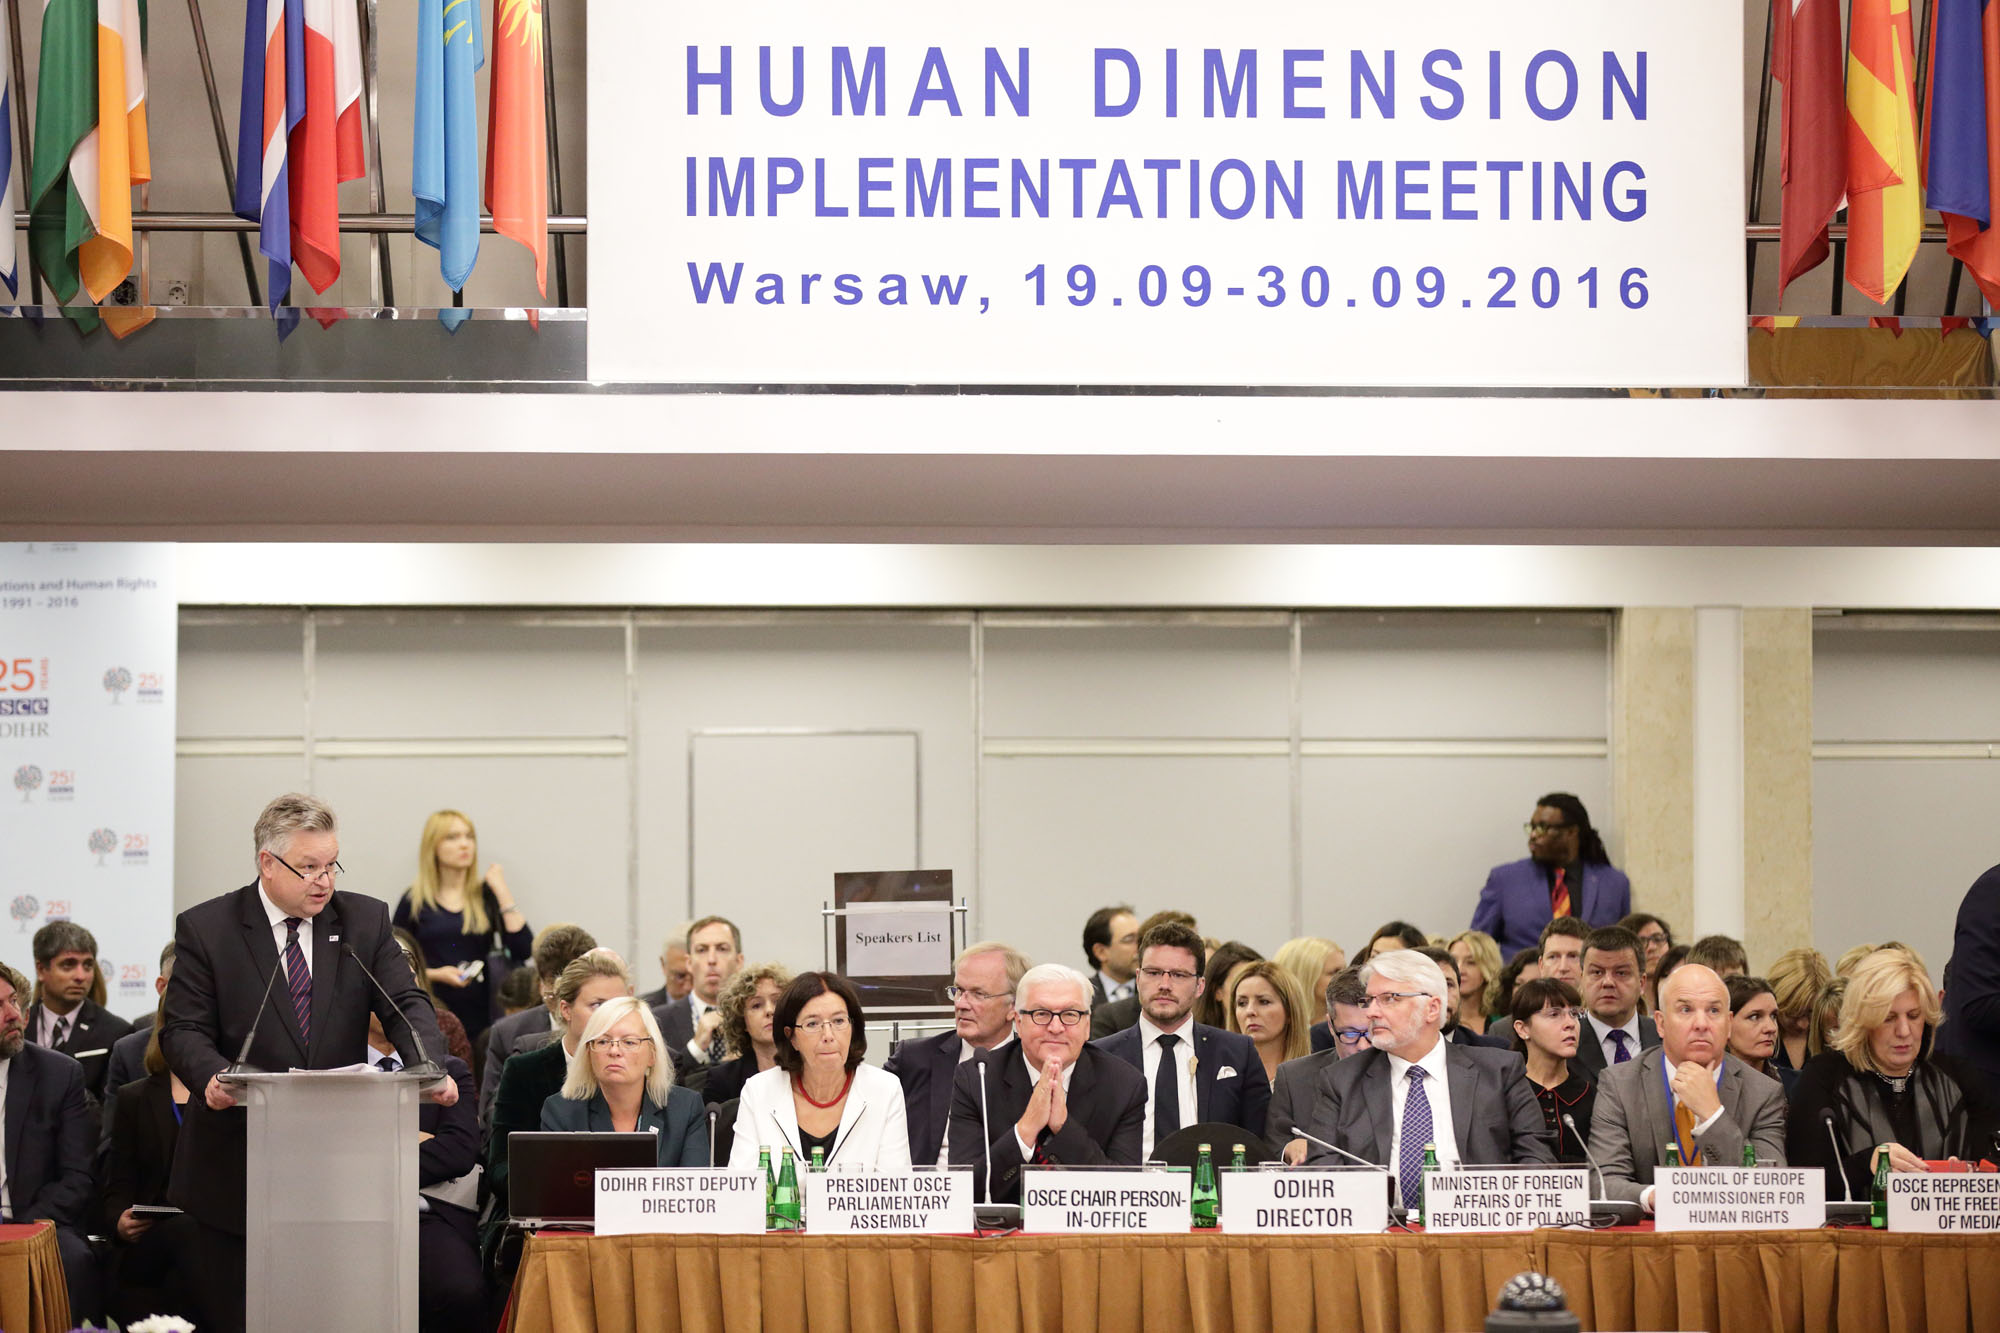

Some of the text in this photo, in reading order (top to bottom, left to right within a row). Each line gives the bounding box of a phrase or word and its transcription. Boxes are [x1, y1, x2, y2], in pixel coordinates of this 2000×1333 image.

[686, 45, 1648, 122] HUMAN DIMENSION
[686, 156, 1647, 223] IMPLEMENTATION MEETING
[686, 261, 1649, 315] Warsaw, 19.09-30.09.2016
[39, 578, 63, 591] and
[66, 578, 113, 591] Human
[116, 577, 158, 595] Rights
[2, 597, 32, 609] 1991
[47, 597, 79, 609] 2016
[855, 931, 941, 947] Speakers List
[600, 1176, 647, 1192] ODIHR
[652, 1176, 695, 1192] FIRST
[699, 1176, 758, 1192] DEPUTY
[826, 1176, 952, 1193] PRESIDENT OSCE
[1432, 1174, 1583, 1191] MINISTER OF FOREIGN
[1672, 1171, 1805, 1186] COUNCIL OF EUROPE
[1892, 1178, 1929, 1194] OSCE
[1274, 1179, 1335, 1199] ODIHR
[828, 1195, 950, 1211] PARLIAMENTARY
[1027, 1189, 1187, 1208] OSCE CHAIR PERSON-
[1453, 1193, 1563, 1209] AFFAIRS OF THE
[1672, 1190, 1805, 1205] COMMISSIONER FOR
[1910, 1196, 2000, 1212] ON THE FREE
[642, 1198, 716, 1214] DIRECTOR
[850, 1213, 928, 1230] ASSEMBLY
[1066, 1210, 1147, 1229] IN-OFFICE
[1256, 1207, 1353, 1228] DIRECTOR
[1432, 1211, 1584, 1228] REPUBLIC OF POLAND
[1689, 1210, 1790, 1224] HUMAN RIGHTS
[1938, 1214, 1957, 1230] OF
